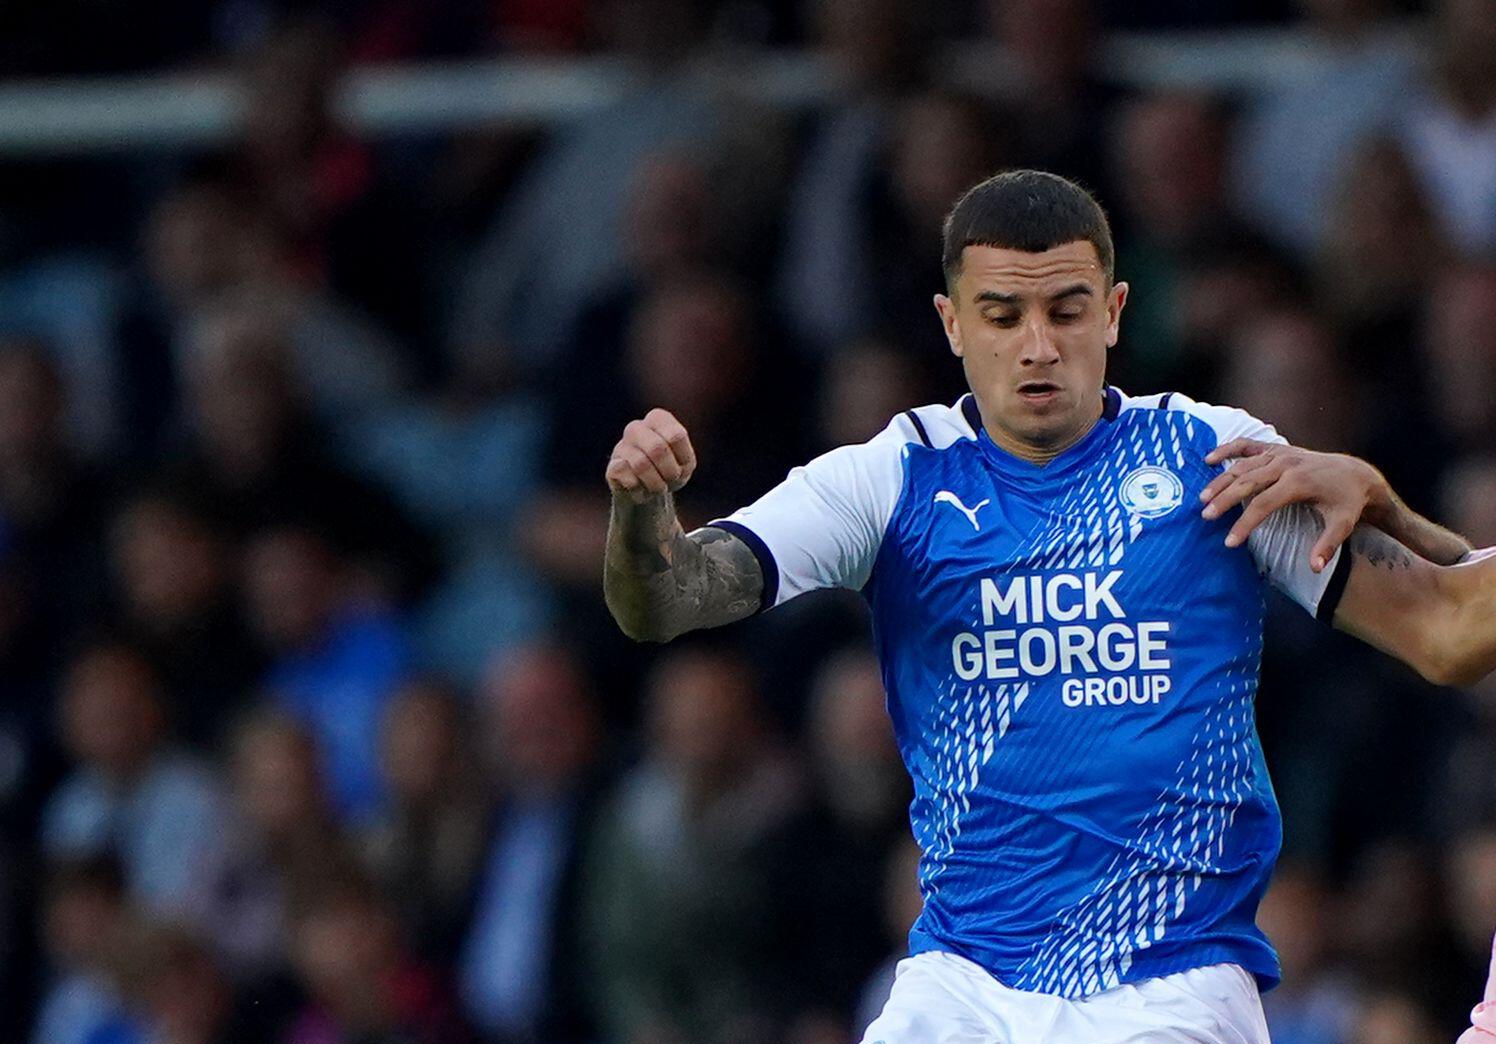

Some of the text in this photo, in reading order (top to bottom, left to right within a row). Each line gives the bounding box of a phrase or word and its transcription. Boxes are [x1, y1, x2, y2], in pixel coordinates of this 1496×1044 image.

[979, 569, 1127, 627] MICK
[951, 621, 1171, 682] GEORGE
[1061, 675, 1172, 708] GROUP
